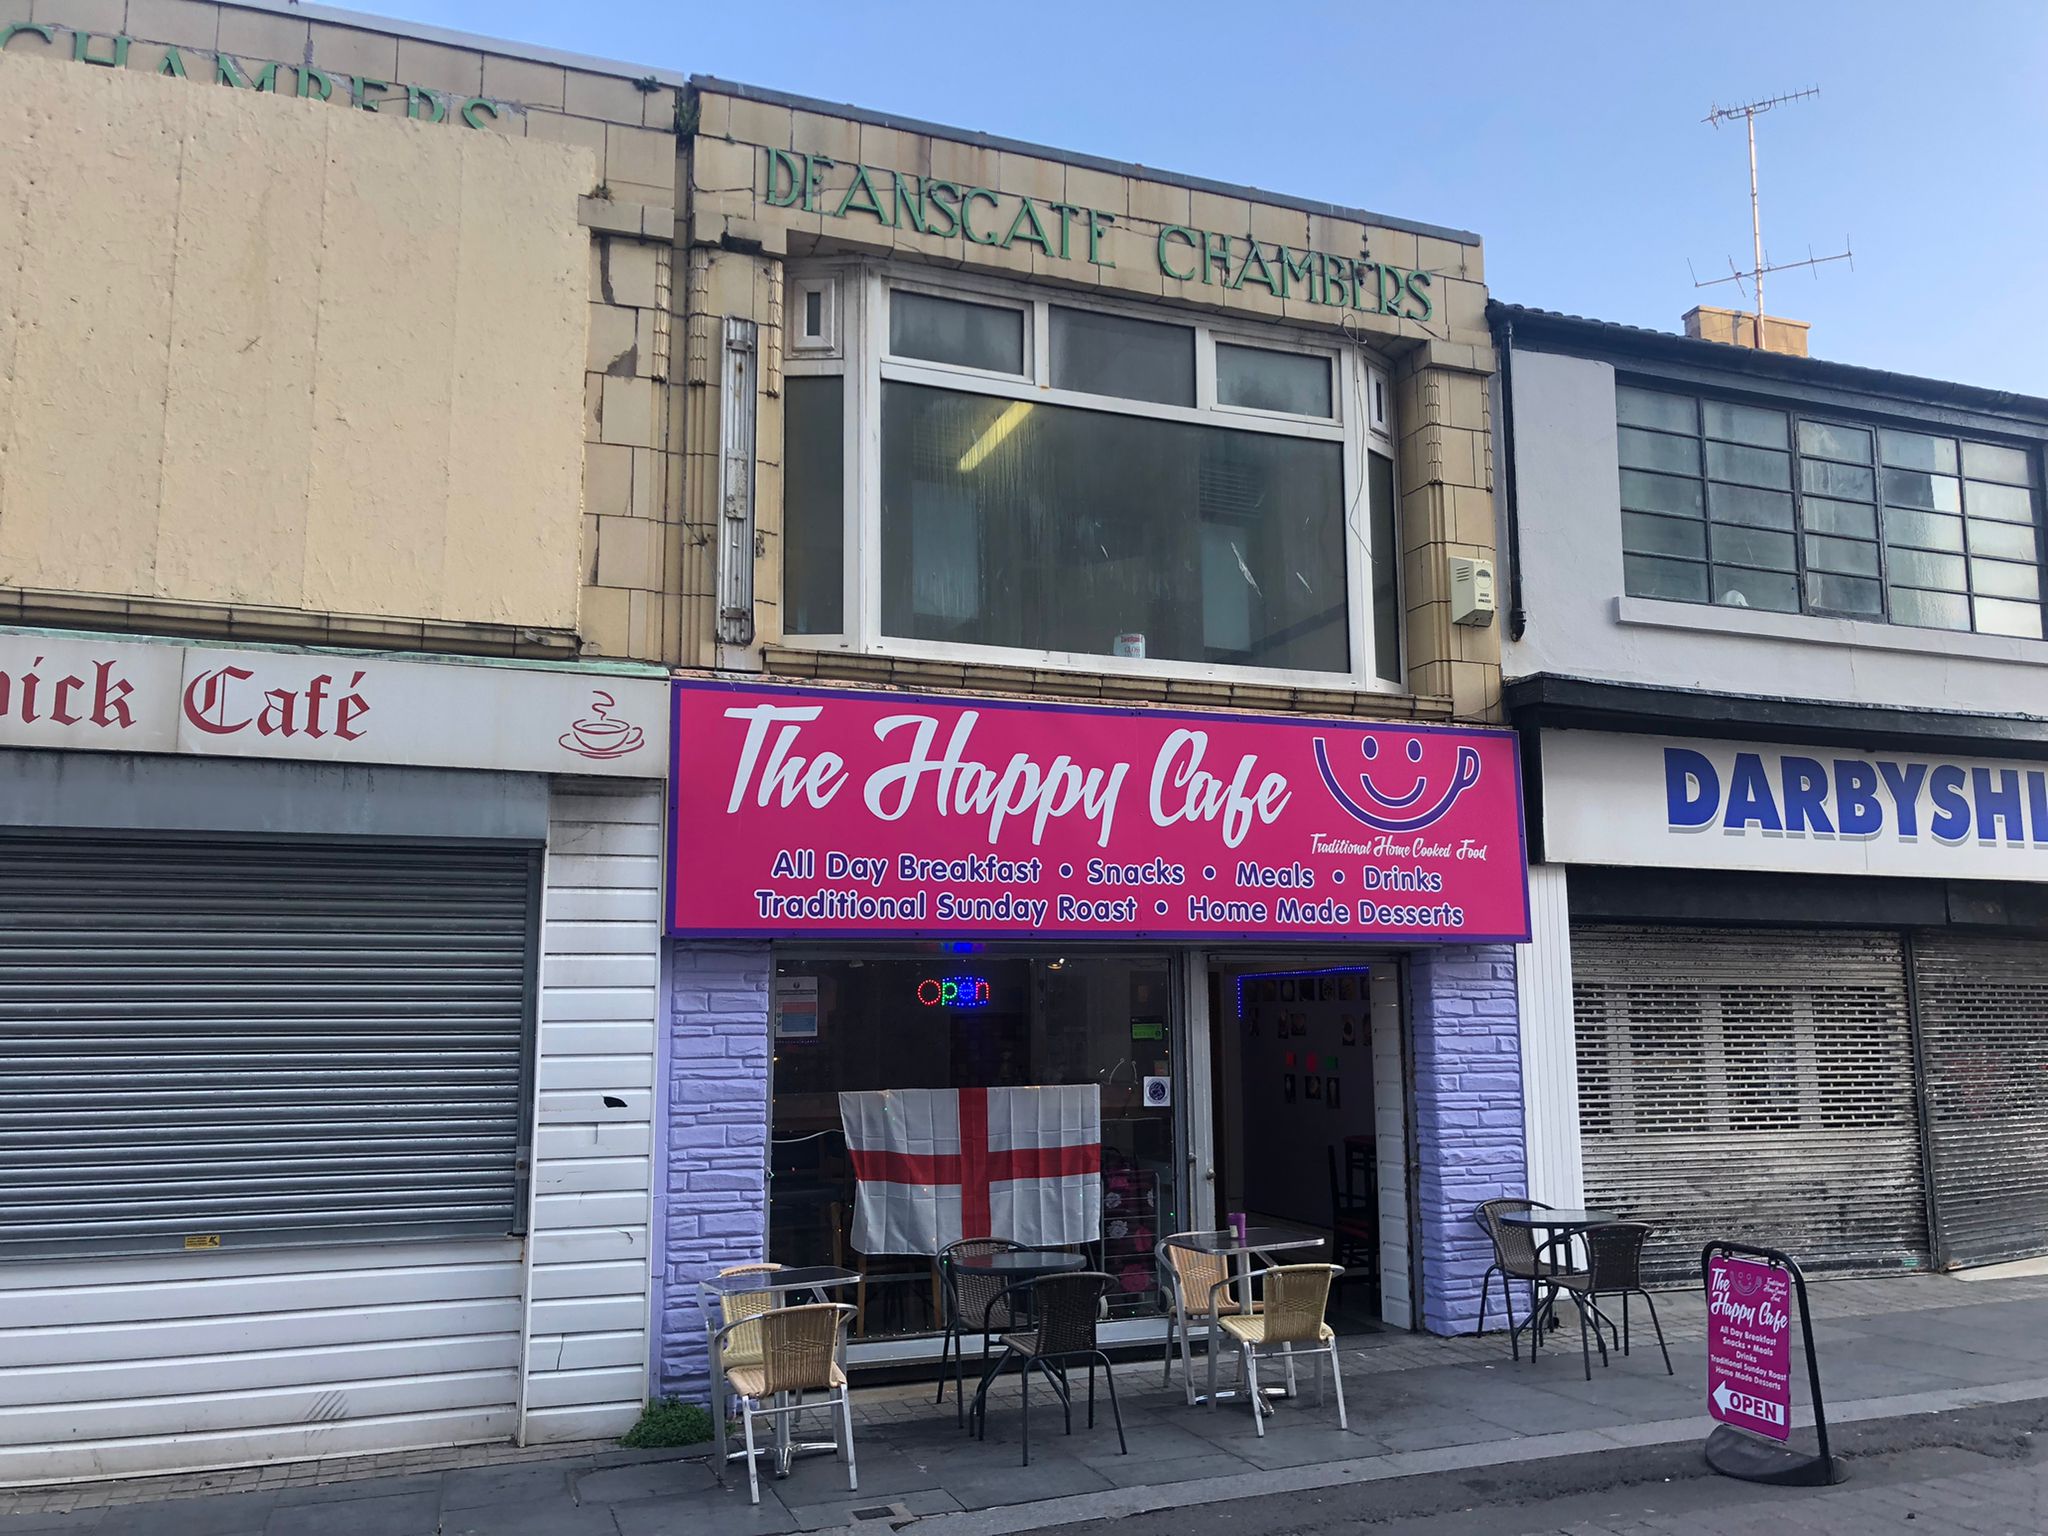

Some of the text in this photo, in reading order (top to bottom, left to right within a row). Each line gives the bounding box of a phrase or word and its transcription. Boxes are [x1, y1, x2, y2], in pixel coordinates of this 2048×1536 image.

[1157, 224, 1433, 322] CHAMBERS
[183, 665, 372, 742] Café
[723, 703, 1292, 849] The Happy Cafe
[1664, 747, 2048, 846] DARBYSHI
[1310, 833, 1487, 861] Traditional Home Cooked Food
[771, 849, 1442, 893] All Day Breakfast Snacks Meals Drinks
[754, 889, 1464, 927] Traditional Sunday Roast Home Made Desserts
[1711, 1267, 1731, 1291] The
[1710, 1291, 1788, 1333] Happy Cafe
[1730, 1327, 1743, 1339] Day
[1744, 1331, 1777, 1346] Breakfast
[1730, 1392, 1776, 1421] OPEN
